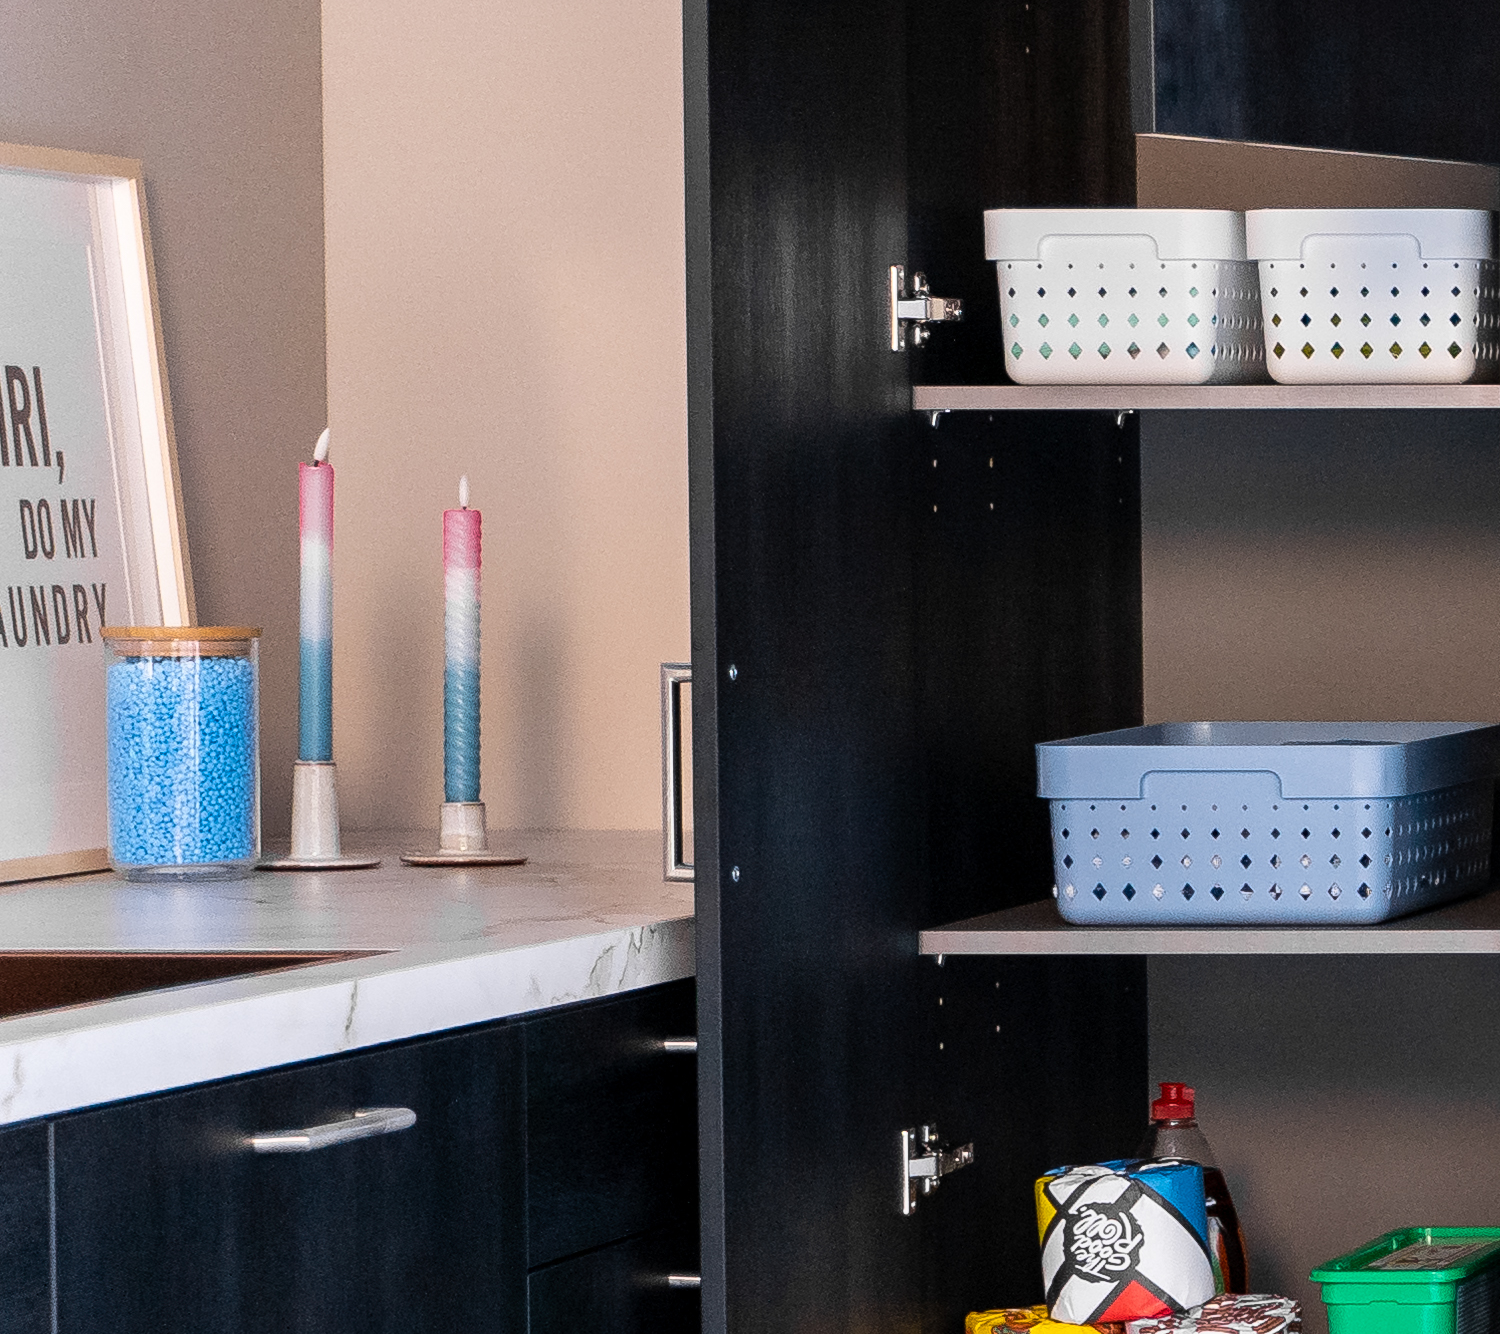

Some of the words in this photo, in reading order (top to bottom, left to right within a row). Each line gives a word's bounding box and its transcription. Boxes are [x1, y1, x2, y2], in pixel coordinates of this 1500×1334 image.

[19, 498, 56, 560] DO
[60, 498, 99, 559] MY
[1070, 1234, 1132, 1272] Good
[1074, 1249, 1112, 1281] The
